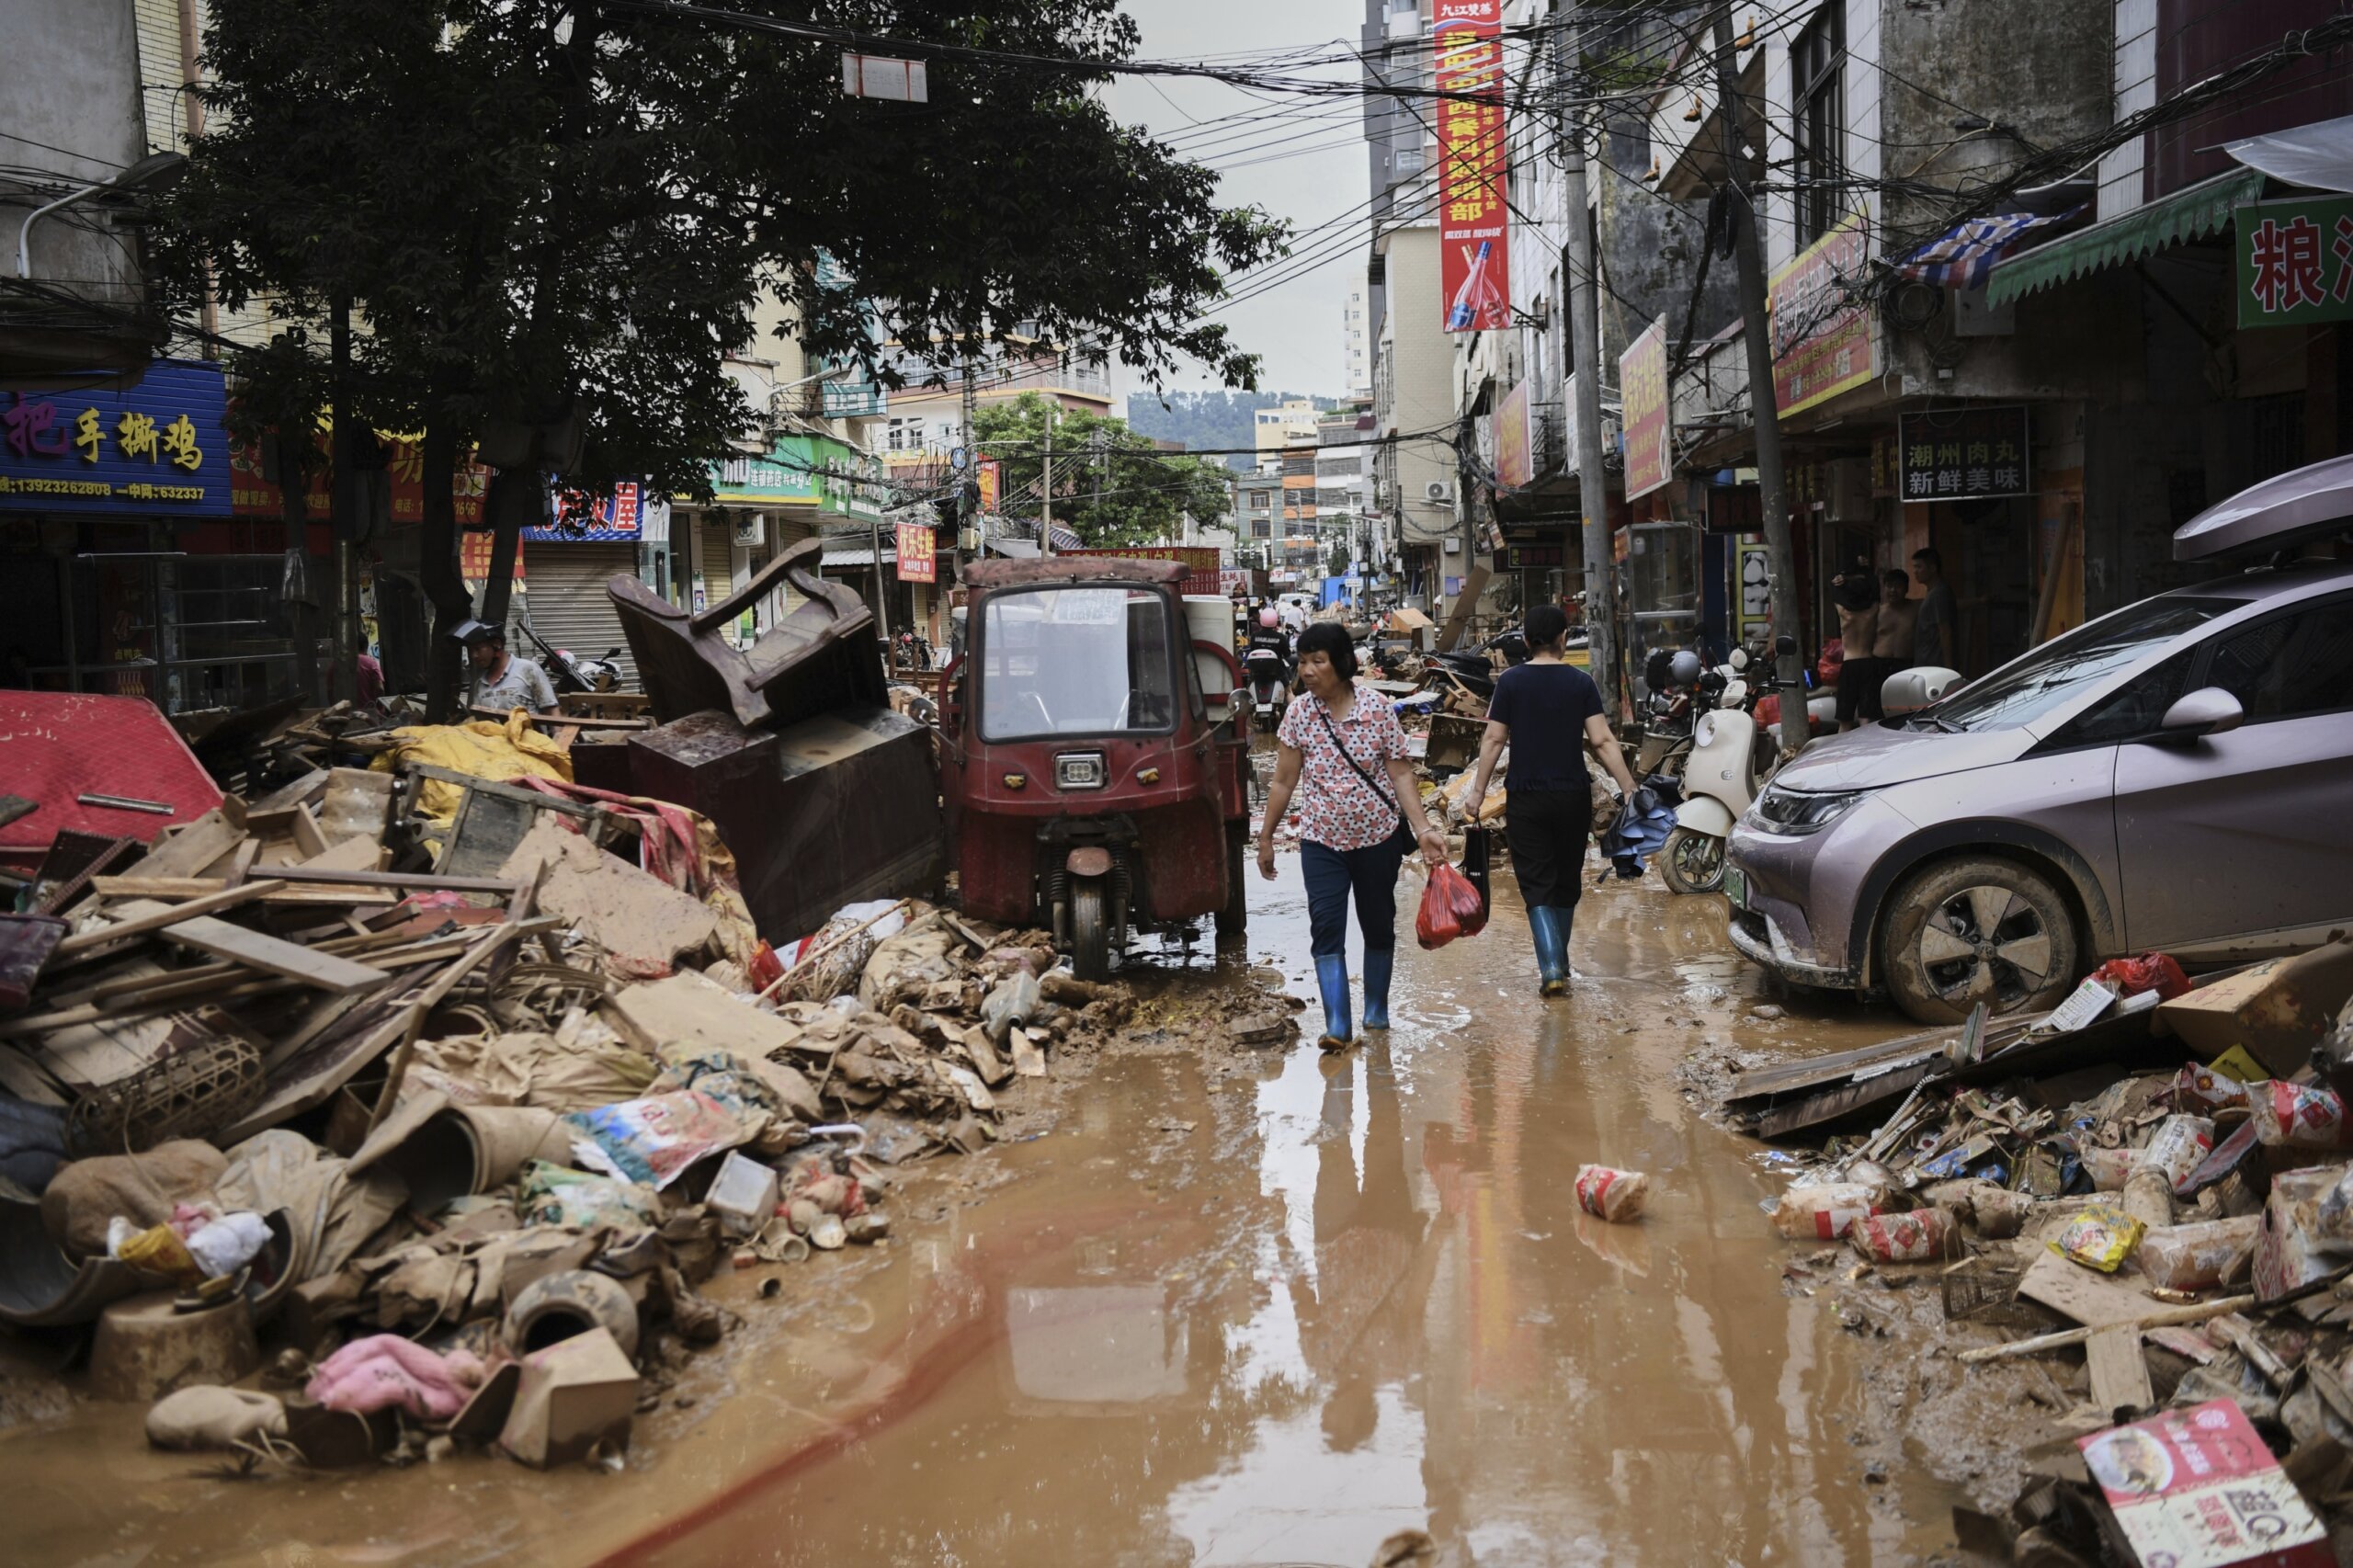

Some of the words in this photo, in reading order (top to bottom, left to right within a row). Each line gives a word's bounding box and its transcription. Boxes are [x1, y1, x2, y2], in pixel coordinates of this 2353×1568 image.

[2251, 214, 2353, 312] 粮
[1908, 439, 2020, 467] 潮州肉丸
[1908, 466, 2021, 494] 新鲜美味
[900, 525, 934, 562] 优乐生鲜
